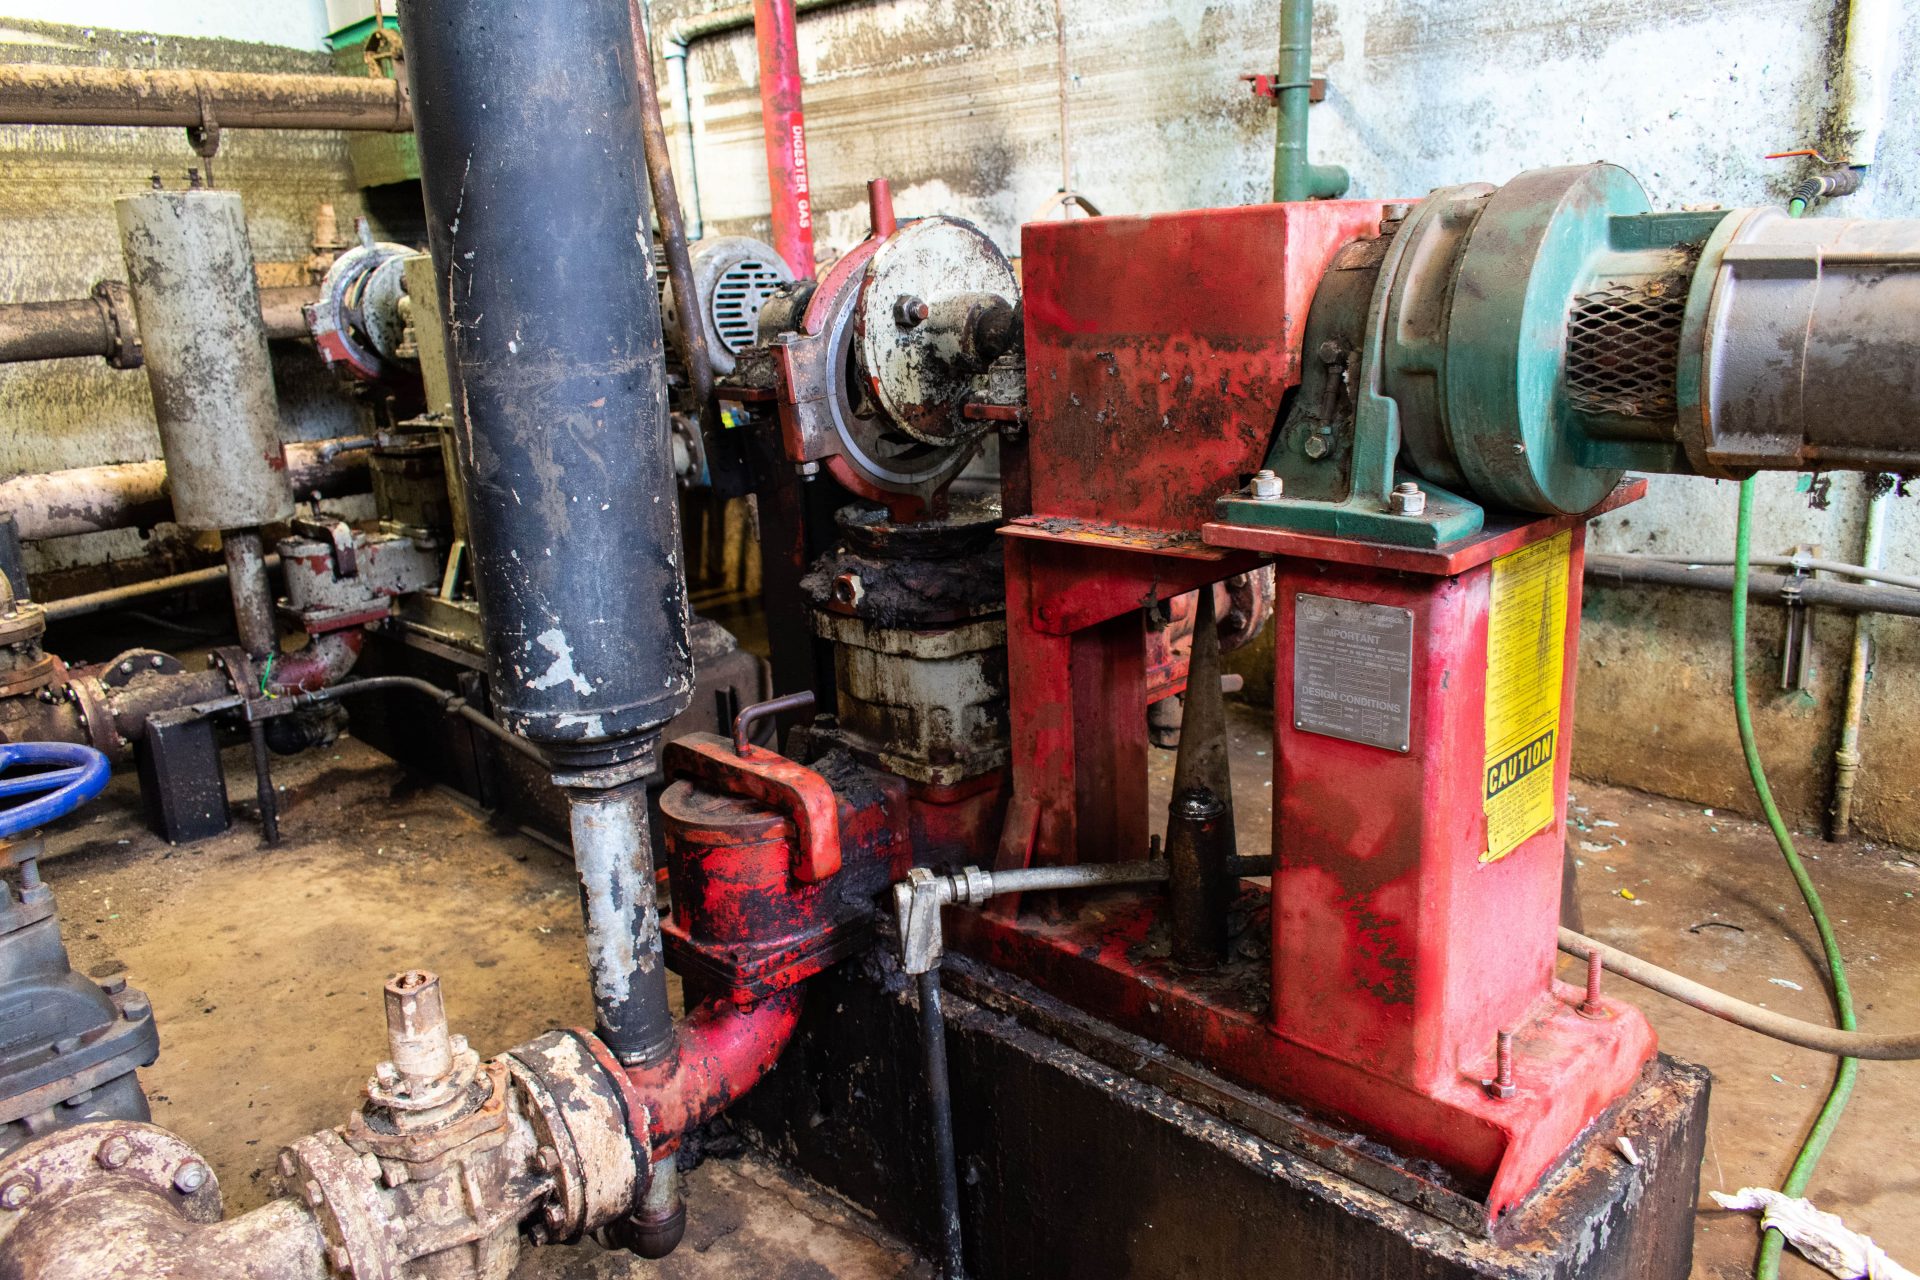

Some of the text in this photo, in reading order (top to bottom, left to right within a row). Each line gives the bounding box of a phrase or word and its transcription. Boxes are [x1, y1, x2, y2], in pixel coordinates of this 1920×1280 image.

[792, 125, 810, 229] DIGESTER GAS
[1323, 628, 1381, 645] IMPORTANT
[1302, 685, 1338, 701] DESIGN
[1339, 693, 1401, 714] CONDITIONS
[1488, 734, 1551, 794] CAUTION
